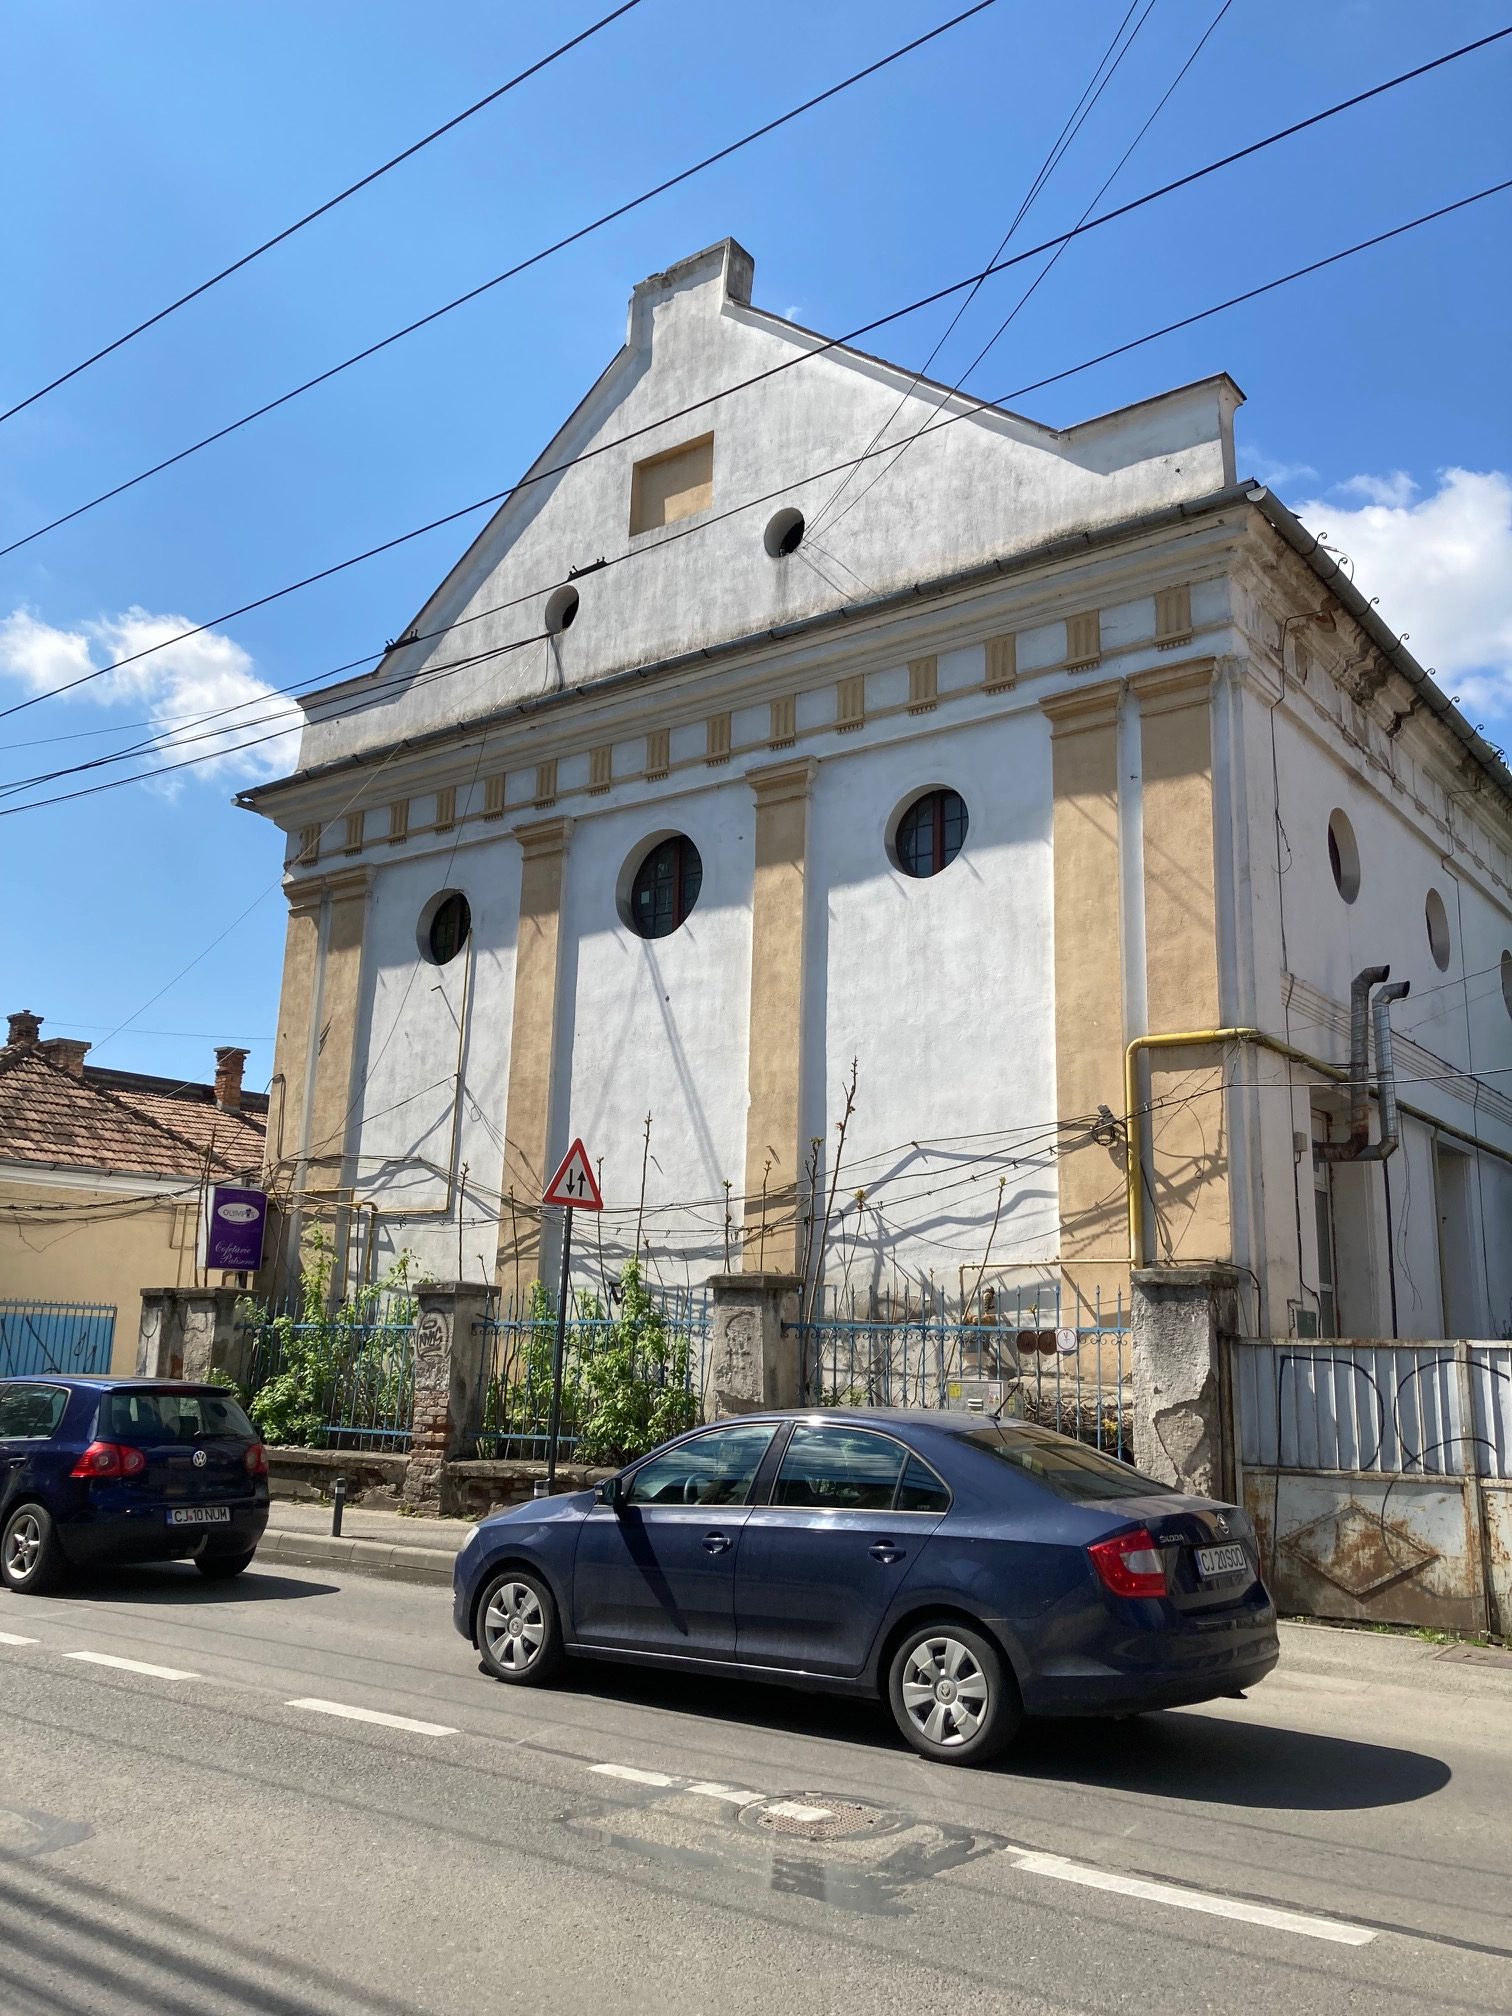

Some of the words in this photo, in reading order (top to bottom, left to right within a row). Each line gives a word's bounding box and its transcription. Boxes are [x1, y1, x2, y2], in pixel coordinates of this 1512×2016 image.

[174, 1510, 189, 1523] CJ
[193, 1509, 204, 1522] 10
[205, 1508, 228, 1521] NUM
[1201, 1551, 1215, 1572] CJ
